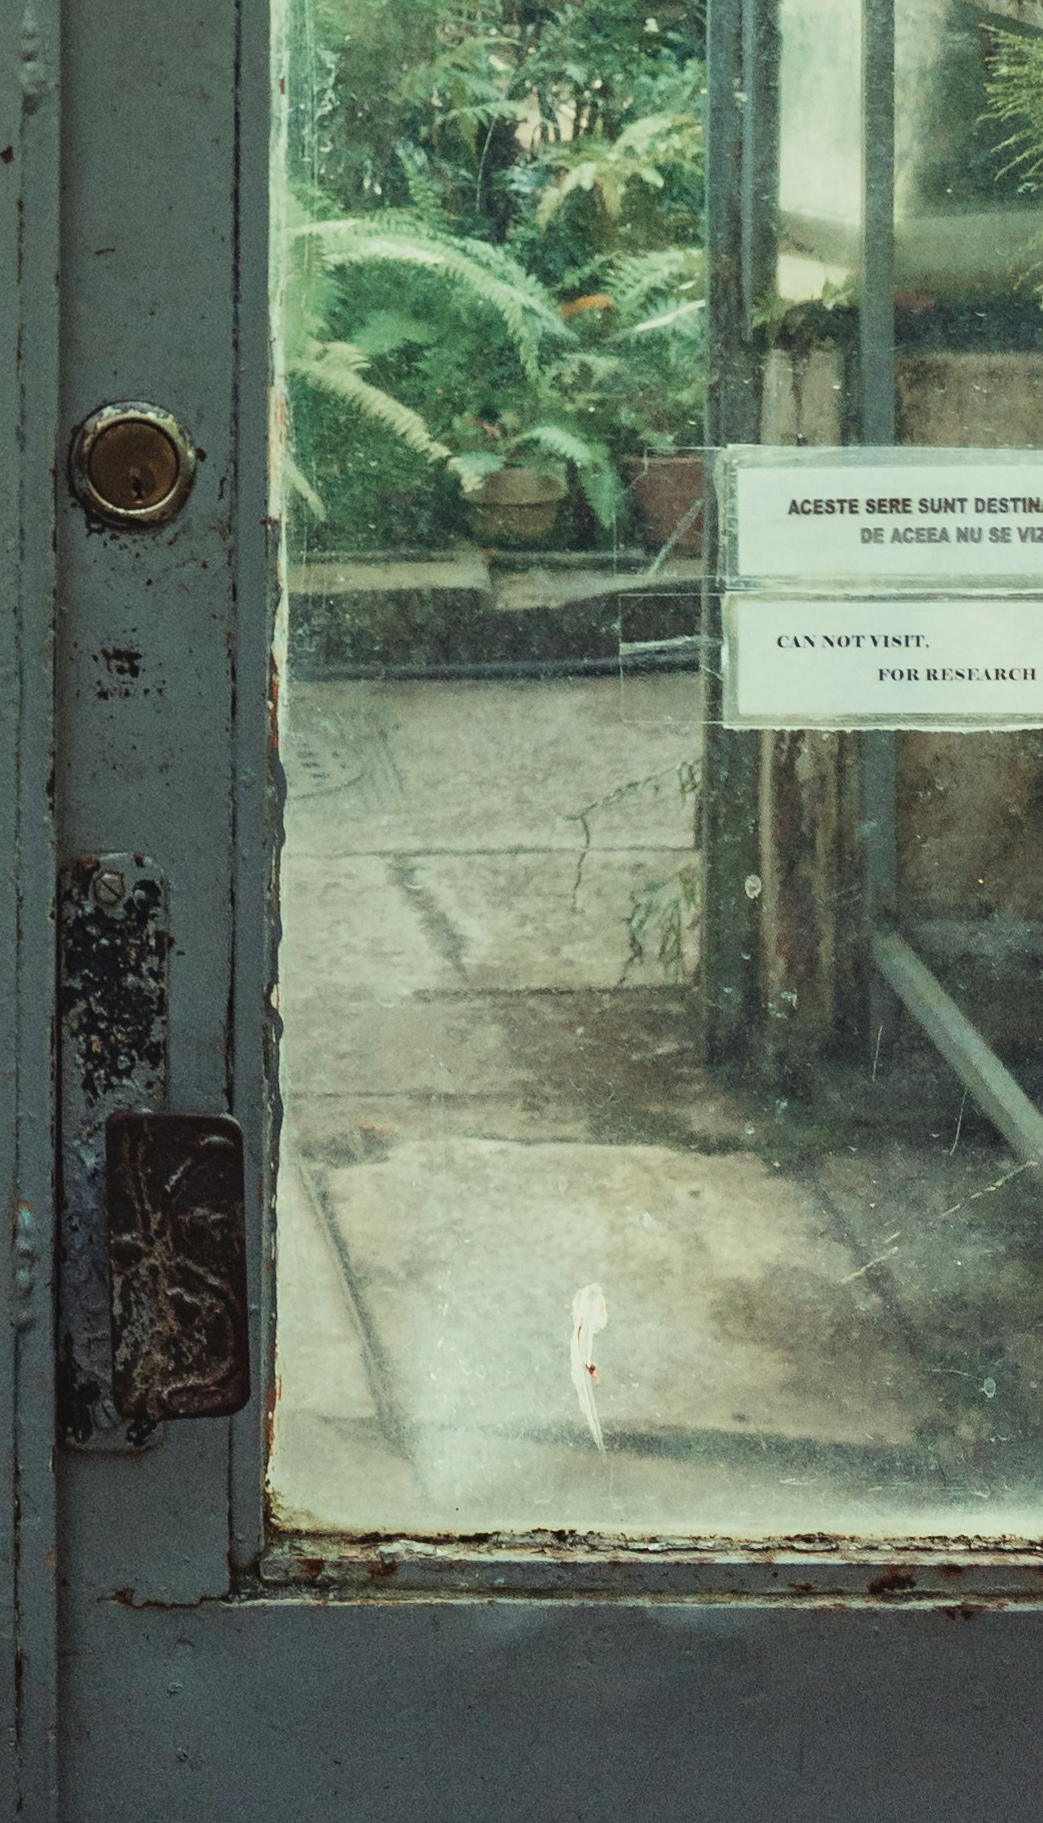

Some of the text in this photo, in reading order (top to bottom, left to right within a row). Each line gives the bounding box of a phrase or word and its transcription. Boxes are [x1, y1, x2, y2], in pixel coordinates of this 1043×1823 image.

[788, 497, 1043, 515] ACESTE SERE SUNT DESTIN
[860, 527, 884, 544] DE
[890, 527, 951, 544] ACEEA
[956, 526, 983, 544] NU
[988, 526, 1012, 544] SE
[776, 634, 931, 650] CAN NOT VISIT,
[878, 667, 1037, 682] FOR RESEARCH
